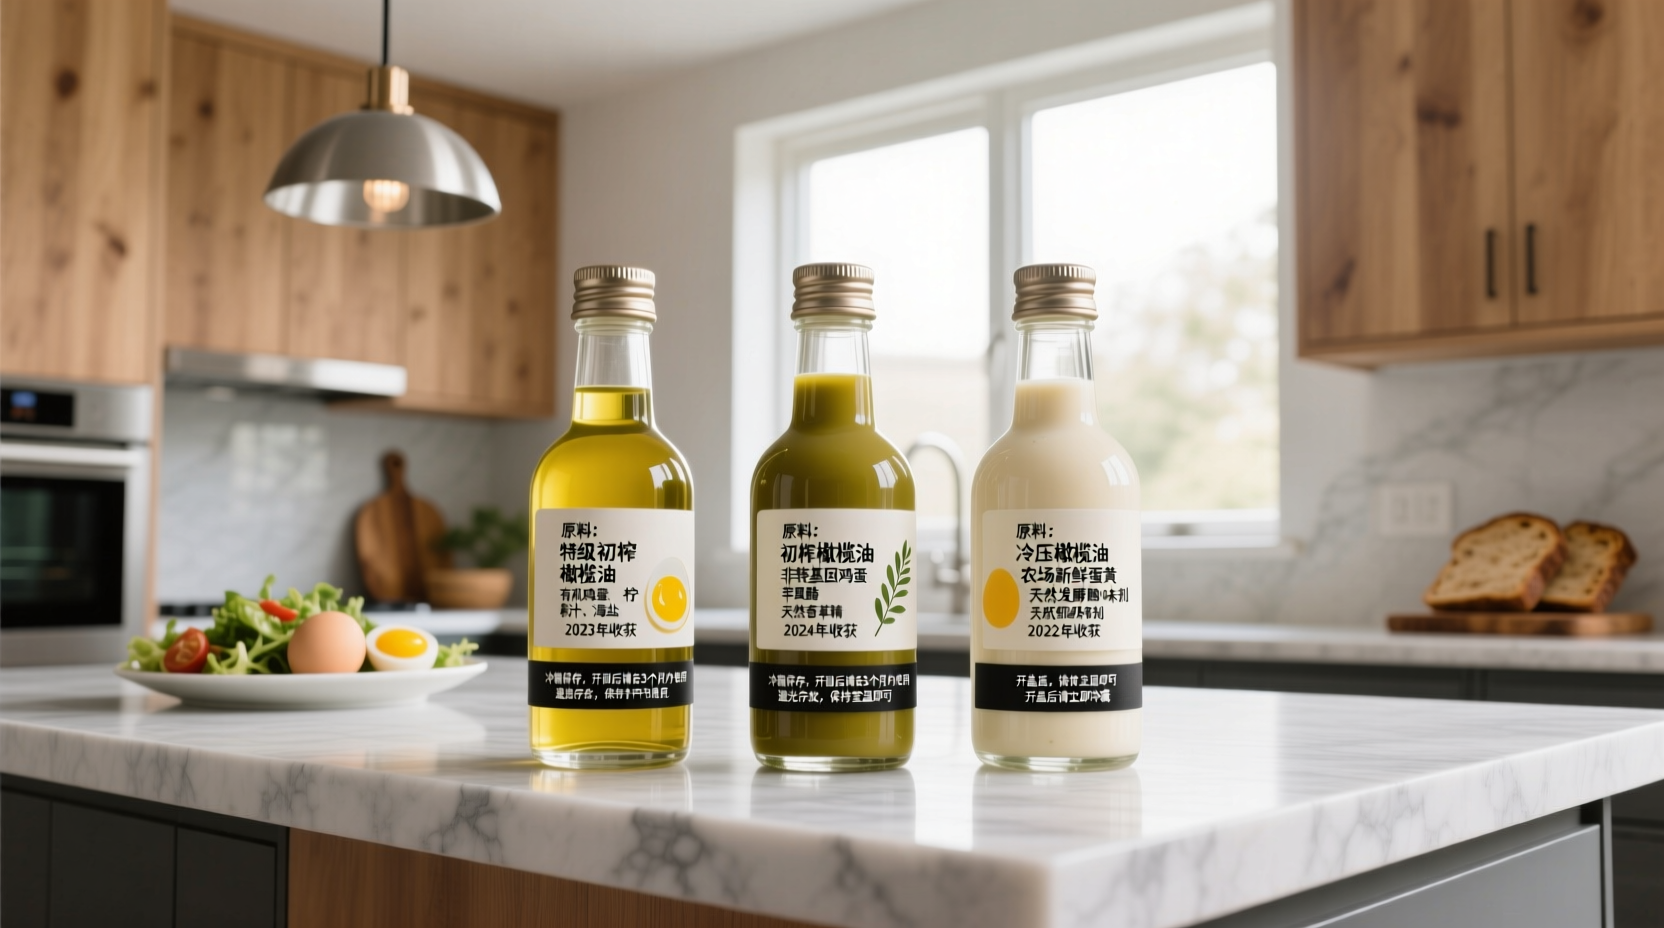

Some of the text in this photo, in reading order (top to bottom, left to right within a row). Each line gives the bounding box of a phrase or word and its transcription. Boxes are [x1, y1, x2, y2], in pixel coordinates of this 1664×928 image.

[559, 540, 637, 562] 特级初榨
[780, 541, 875, 564] 初榨橄榄油
[1015, 542, 1109, 563] 冷压橄榄油
[559, 563, 616, 584] 橄榄油
[564, 622, 637, 637] 2023年收获
[783, 623, 858, 638] 2024年收获
[1027, 624, 1101, 638] 2022年收获
